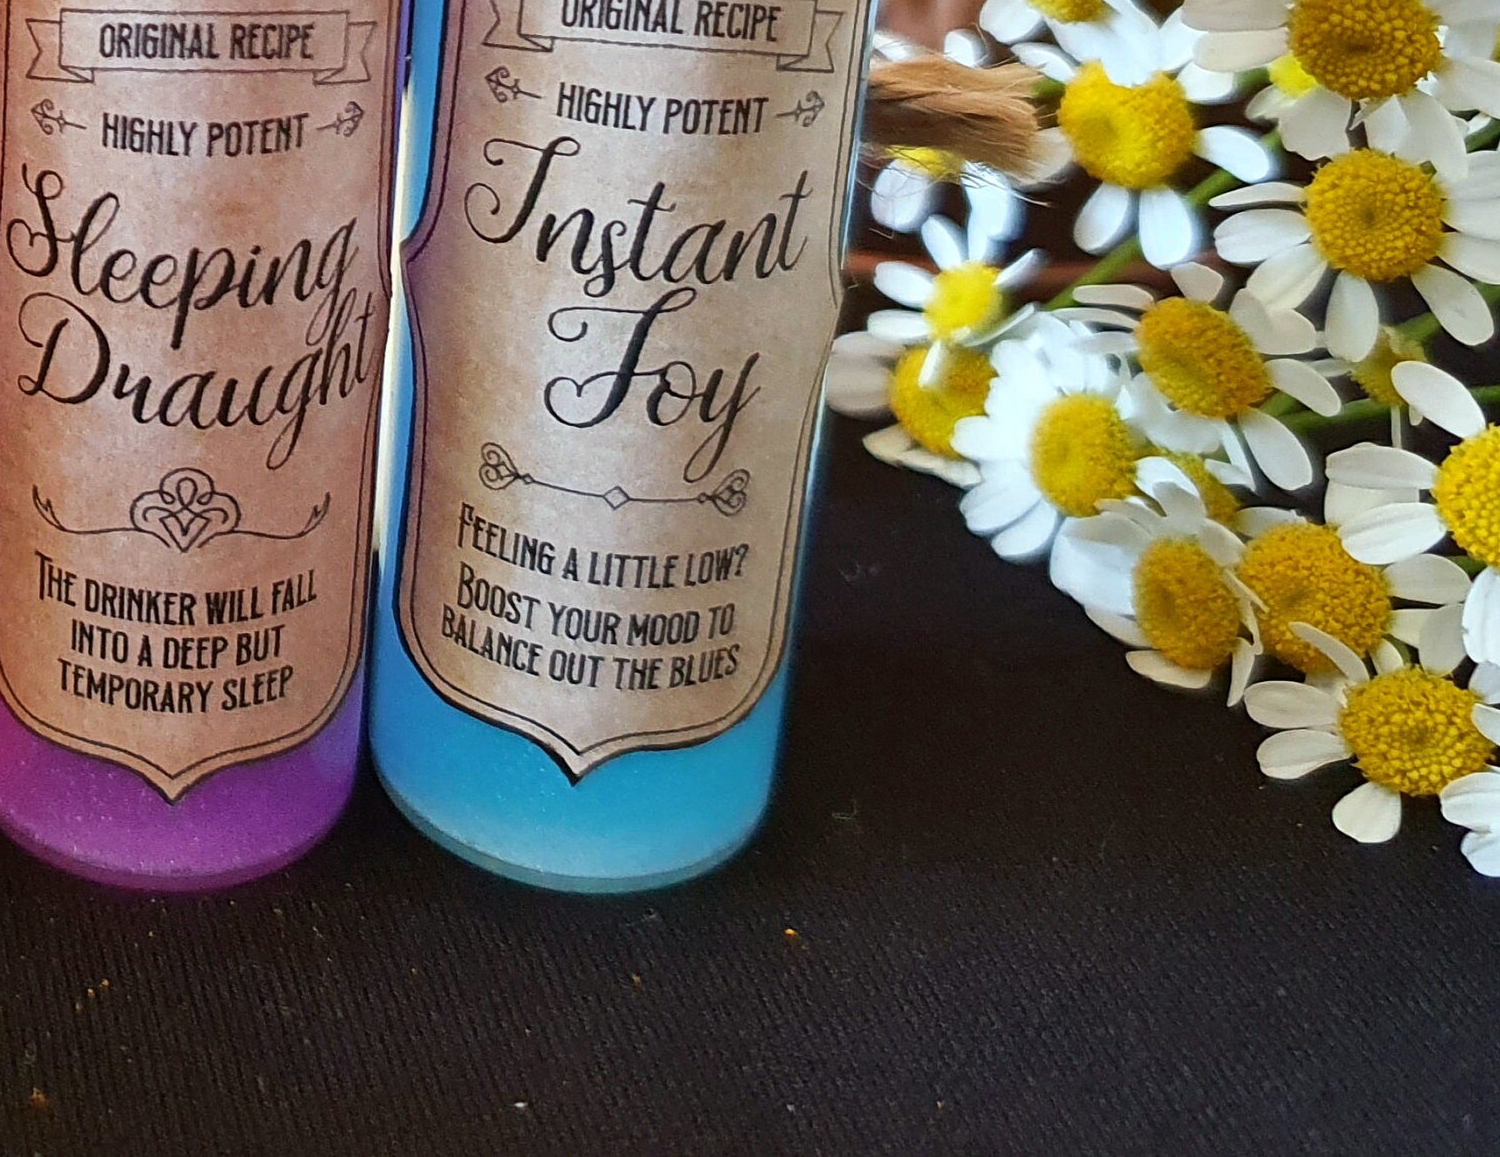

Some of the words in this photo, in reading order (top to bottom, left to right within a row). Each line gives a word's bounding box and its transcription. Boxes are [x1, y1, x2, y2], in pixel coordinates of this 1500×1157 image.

[99, 22, 220, 60] ORIGINAL
[229, 23, 315, 60] RECIPE
[694, 0, 782, 42] RECIPE
[102, 112, 197, 156] HIGHLY
[206, 114, 308, 157] POTENT
[557, 82, 656, 132] HIGHLY
[663, 97, 769, 135] POTENT
[464, 136, 813, 298] Instant
[6, 163, 359, 350] Sleeping
[18, 287, 375, 470] Draught
[544, 287, 761, 483] Joy
[562, 551, 578, 583] A
[589, 552, 677, 589] LITTLE
[684, 544, 750, 586] LOW?
[85, 578, 196, 626] DRINKER
[205, 586, 263, 623] WILL
[271, 569, 316, 615] FALL
[548, 601, 621, 645] YOUR
[627, 611, 700, 647] MOOD
[709, 604, 735, 640] TO
[71, 619, 128, 663] INTO
[137, 635, 152, 668] A
[163, 637, 228, 670] DEEP
[236, 625, 285, 665] BUT
[441, 604, 540, 676] BALANCE
[548, 649, 604, 688] OUT
[613, 658, 663, 691] THE
[669, 644, 740, 688] BLUES
[58, 658, 212, 713] TEMPORARY
[222, 665, 293, 711] SLEEP
